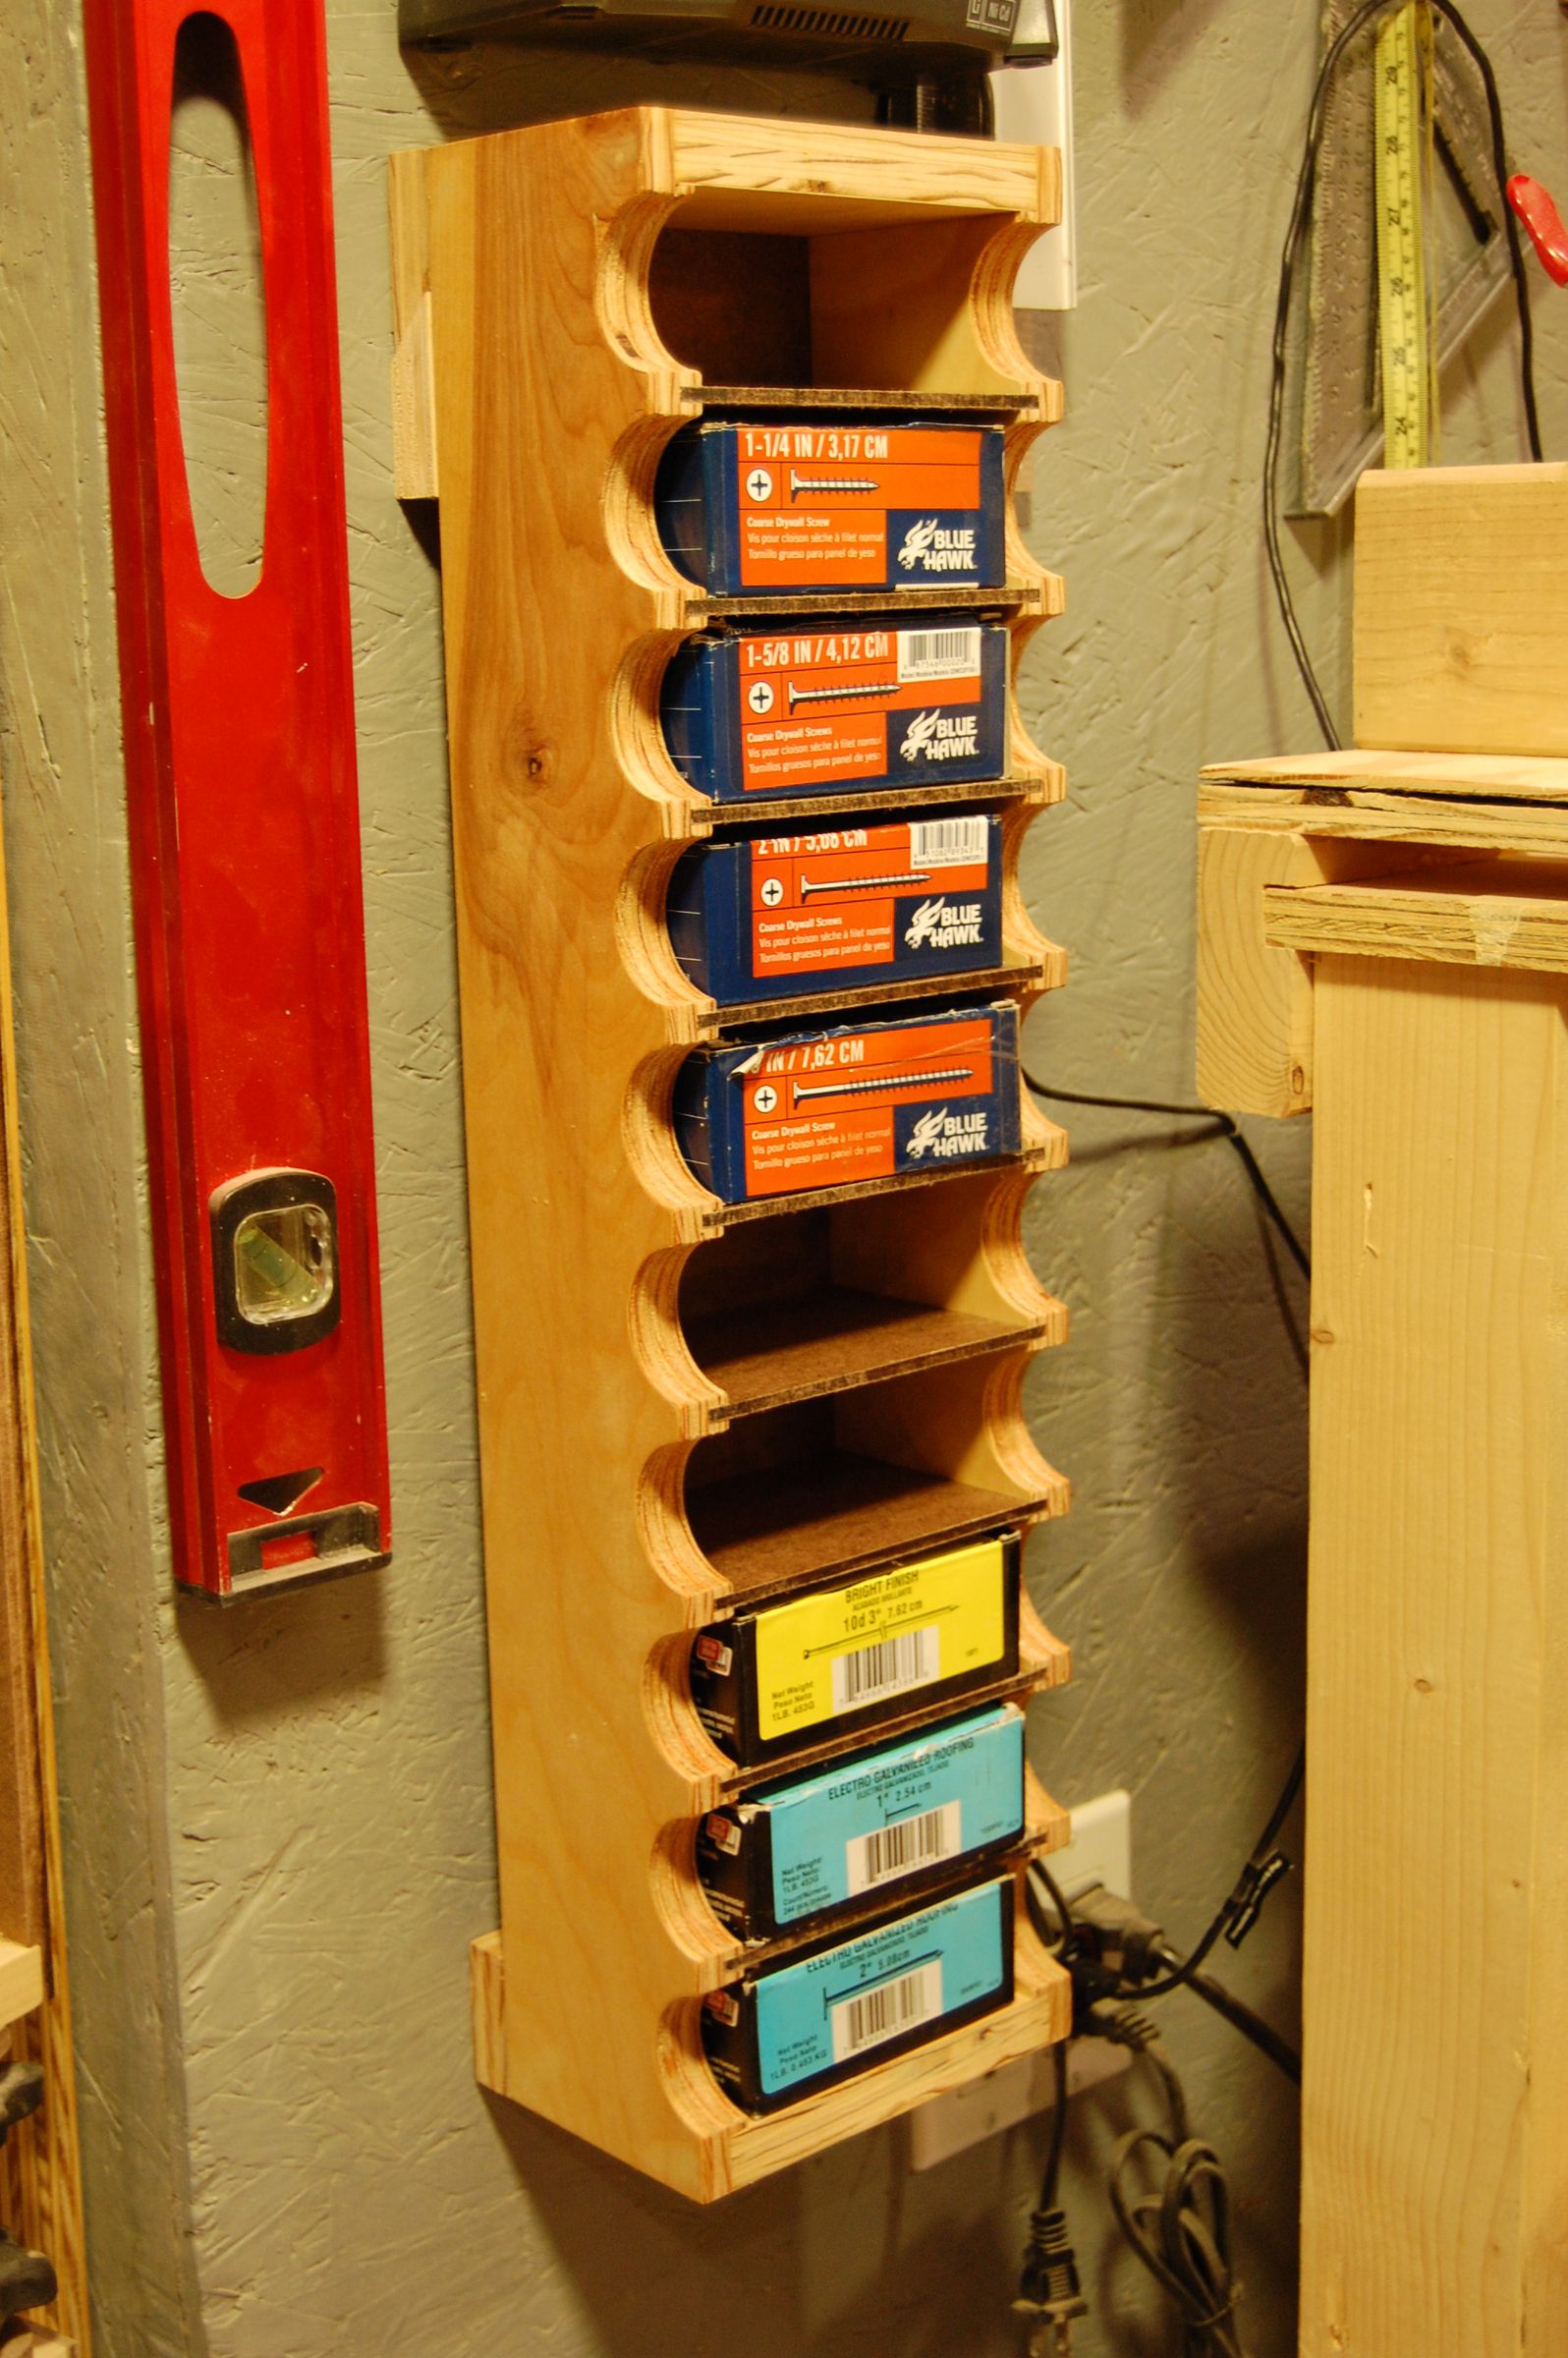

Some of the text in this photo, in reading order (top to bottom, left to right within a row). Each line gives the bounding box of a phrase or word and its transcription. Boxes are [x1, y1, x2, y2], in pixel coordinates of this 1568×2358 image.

[1387, 207, 1400, 227] 27
[745, 432, 790, 458] 1-1/4
[794, 433, 812, 458] IN
[828, 434, 861, 461] 3,17
[865, 434, 888, 459] CM
[747, 517, 830, 530] Coarse Drywall Screw
[934, 530, 976, 549] BLUE
[924, 550, 975, 572] HAWK
[747, 642, 789, 668] 1-5/8
[794, 640, 812, 664] IN
[826, 636, 861, 664] 4,12
[865, 634, 888, 658] CM
[747, 732, 773, 743] Coarse
[775, 728, 804, 742] Drywall
[936, 716, 978, 739] BLUE
[925, 736, 976, 760] HAWK
[771, 838, 790, 854] IN
[842, 829, 868, 848] CM
[758, 923, 785, 933] Coarse
[786, 919, 814, 931] Drywall
[940, 904, 982, 926] BLUE
[929, 924, 980, 949] HAWK
[766, 1051, 785, 1072] IN
[802, 1042, 835, 1070] 7,62
[839, 1039, 865, 1063] CM
[752, 1121, 836, 1141] Coarse Drywall Screw
[944, 1112, 988, 1137] BLUE
[932, 1132, 986, 1157] HAWK
[846, 1569, 919, 1603] BRIGHT FINISH
[844, 1612, 866, 1633] 10d
[887, 1602, 907, 1618] 7.62
[909, 1600, 923, 1611] cm
[828, 1774, 871, 1800] ELECTRO
[895, 1786, 916, 1802] 2.54
[919, 1781, 931, 1793] cm
